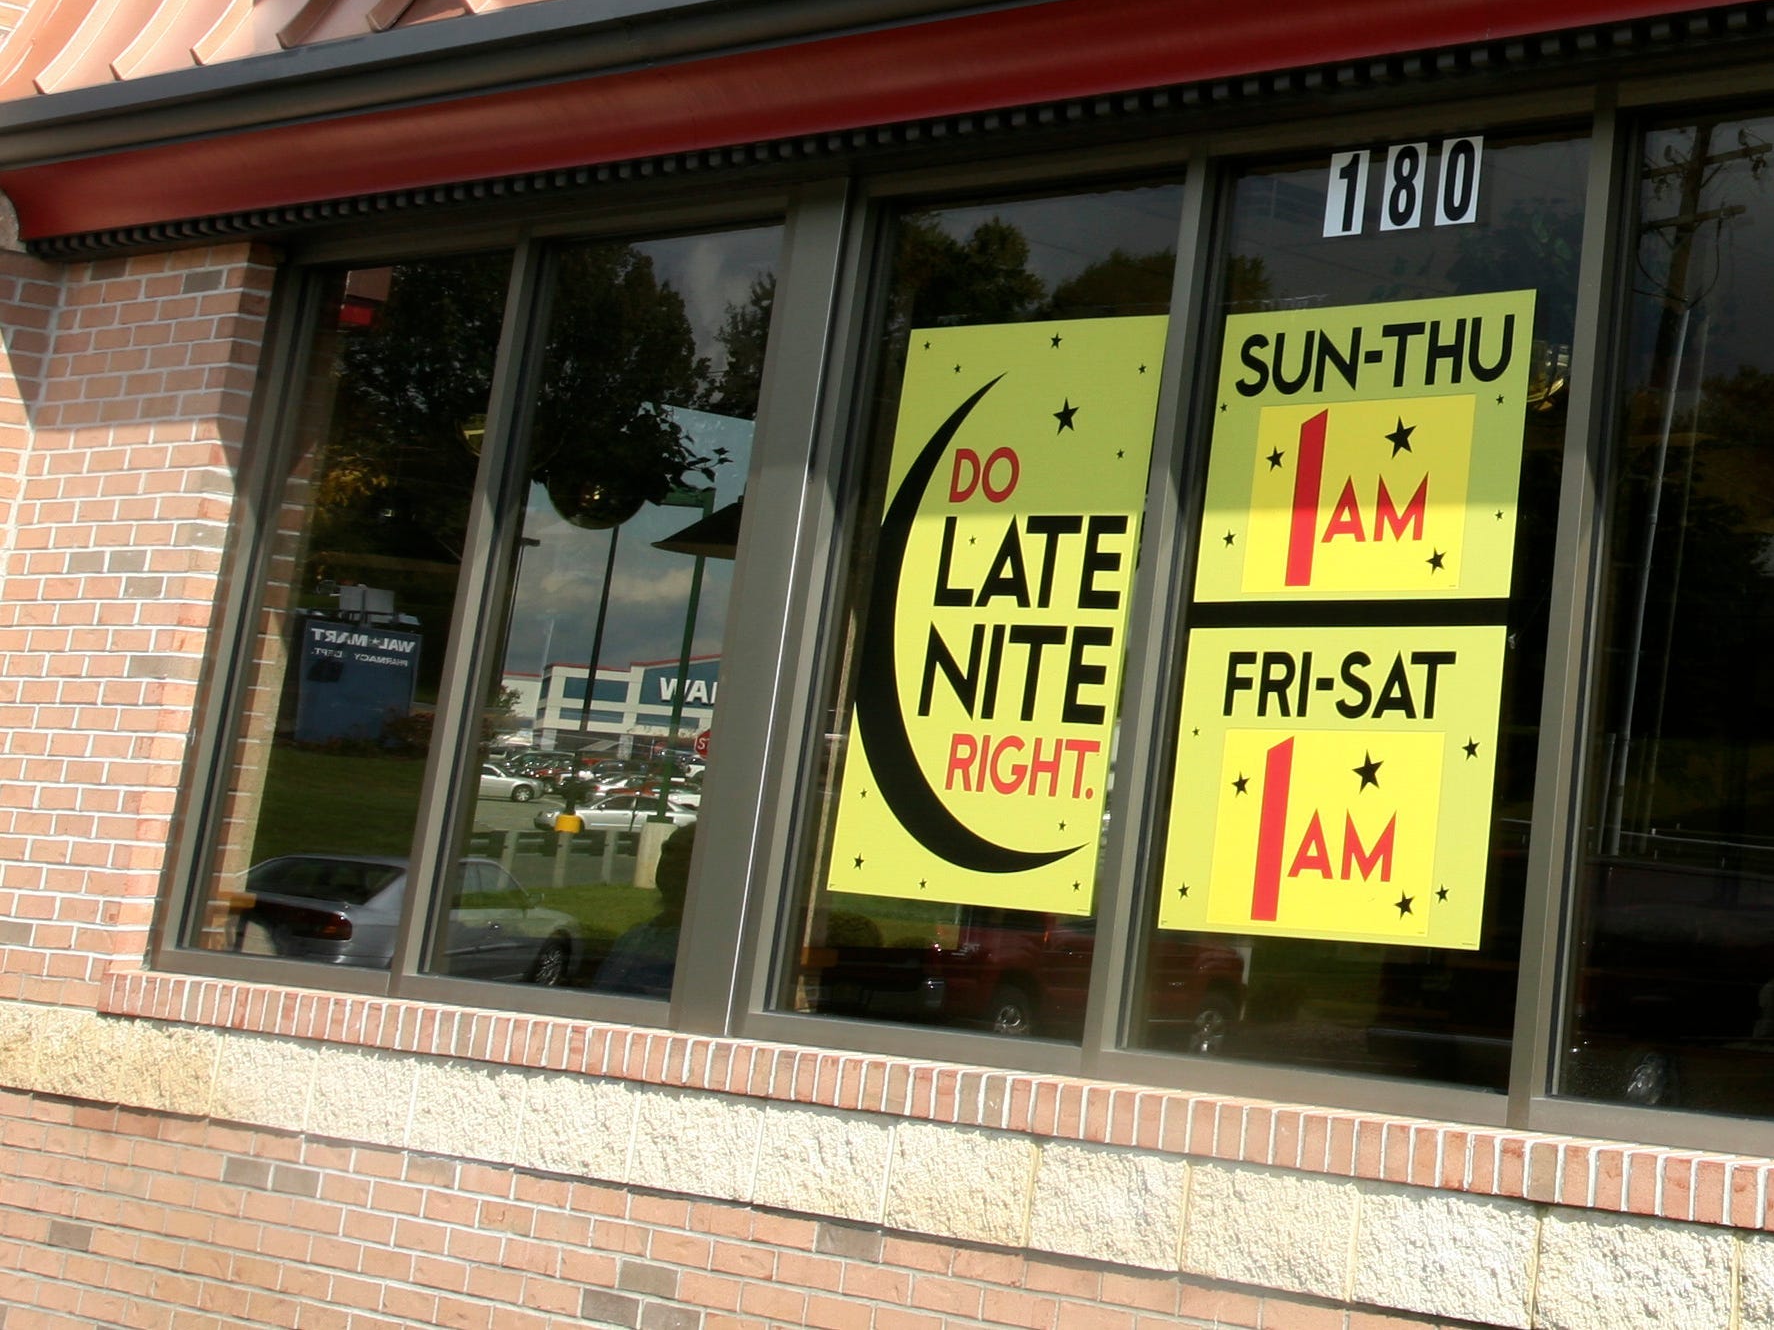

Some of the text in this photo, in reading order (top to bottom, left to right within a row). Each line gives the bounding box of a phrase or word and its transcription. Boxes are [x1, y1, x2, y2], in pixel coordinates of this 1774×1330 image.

[1338, 138, 1476, 233] 180
[1235, 314, 1517, 399] SUN-THU
[948, 446, 1020, 504] DO
[932, 514, 1129, 610] LATE
[917, 623, 1115, 726] NITE
[1223, 650, 1457, 720] FRI-SAT
[944, 734, 1101, 801] RIGHT.
